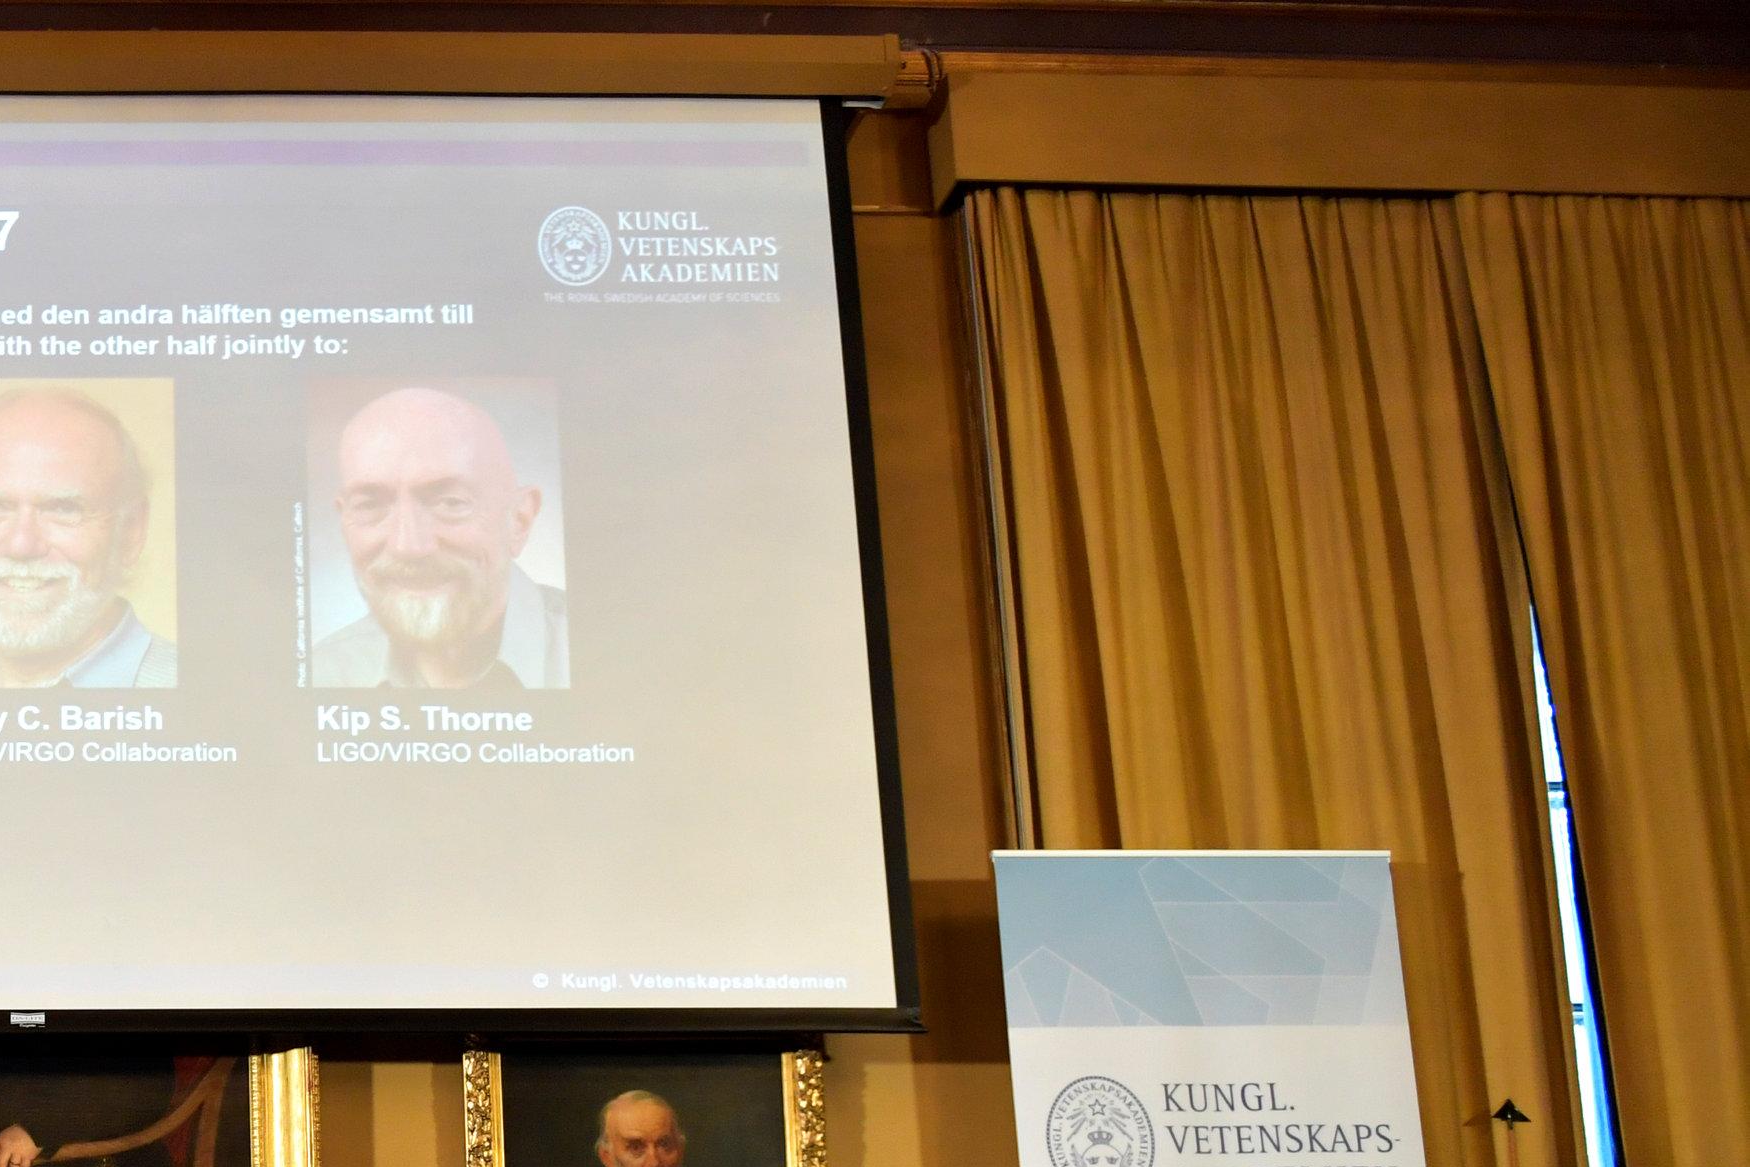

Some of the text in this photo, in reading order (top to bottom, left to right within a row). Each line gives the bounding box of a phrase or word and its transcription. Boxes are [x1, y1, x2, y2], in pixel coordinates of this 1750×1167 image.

[618, 211, 710, 231] KUNGL.
[620, 262, 779, 283] AKADEMIEN
[40, 304, 90, 325] den
[97, 304, 174, 325] andra
[181, 303, 272, 325] hälften
[280, 304, 435, 329] gemensamt
[440, 303, 474, 325] till
[39, 335, 82, 356] the
[89, 335, 160, 356] other
[167, 334, 218, 356] half
[221, 334, 306, 360] jointly
[313, 335, 348, 355] to:
[17, 705, 50, 731] C.
[60, 704, 163, 731] Barish
[317, 704, 534, 737] Kip S. Thorne
[81, 741, 237, 762] Collaboration
[317, 741, 634, 763] LIGO/VIRGO Collaboration
[561, 972, 623, 993] Kungl.
[629, 973, 848, 992] Vetenskapsakademien
[1162, 1082, 1295, 1113] KUNGL.
[1165, 1123, 1401, 1155] VETENSKAPS-
